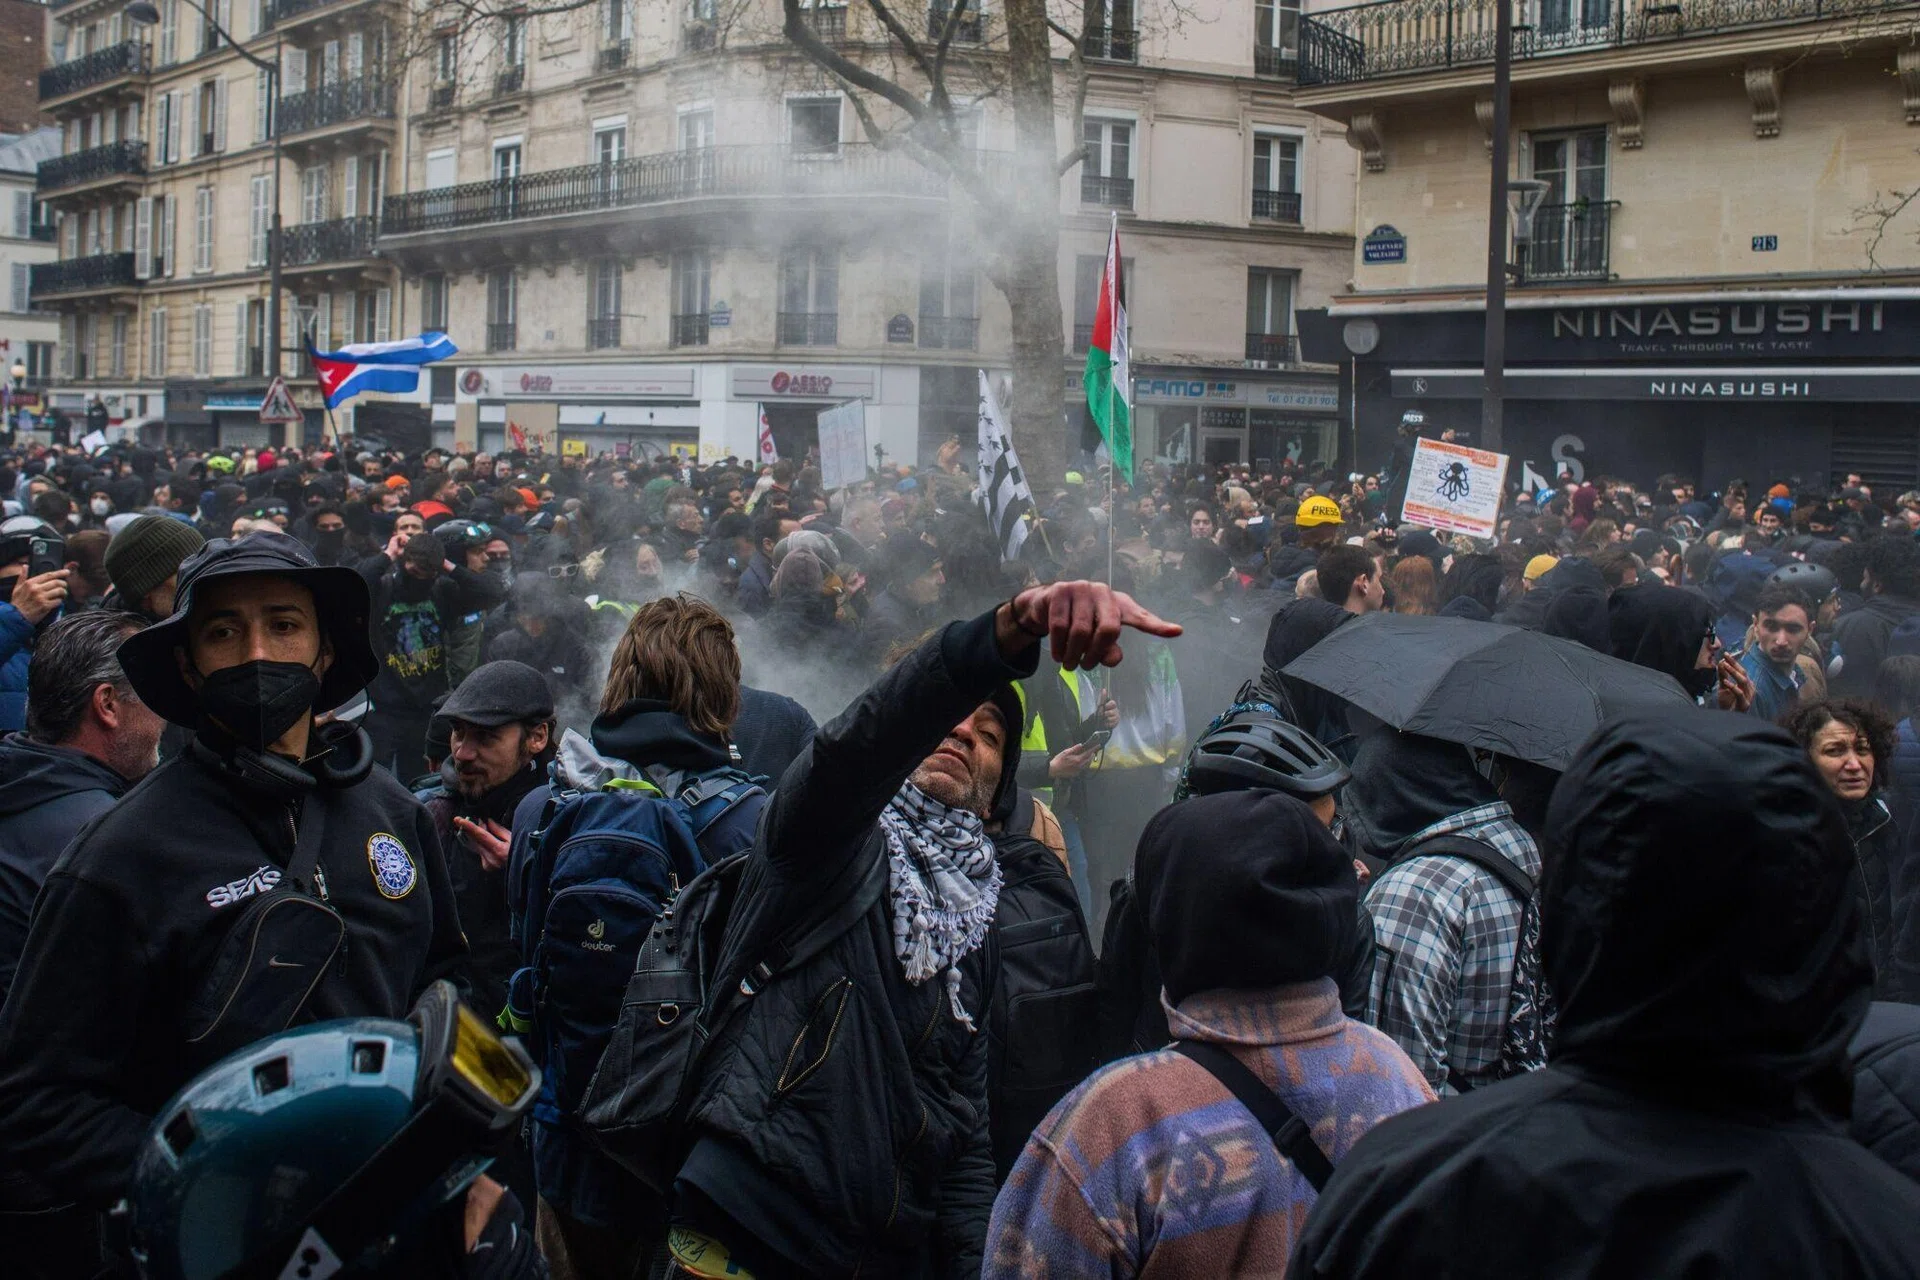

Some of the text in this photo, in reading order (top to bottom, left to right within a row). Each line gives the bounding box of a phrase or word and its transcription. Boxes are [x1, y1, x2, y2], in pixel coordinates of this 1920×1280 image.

[1753, 236, 1776, 250] 213
[1553, 301, 1884, 337] NINASUSHI
[1619, 343, 1665, 353] TRAVEL
[1671, 342, 1734, 352] THROUGH
[1739, 342, 1765, 351] THE
[1651, 382, 1810, 396] NINASUSHI
[1403, 414, 1424, 422] PRESS
[1311, 505, 1340, 516] PRESS
[581, 941, 617, 951] deuter
